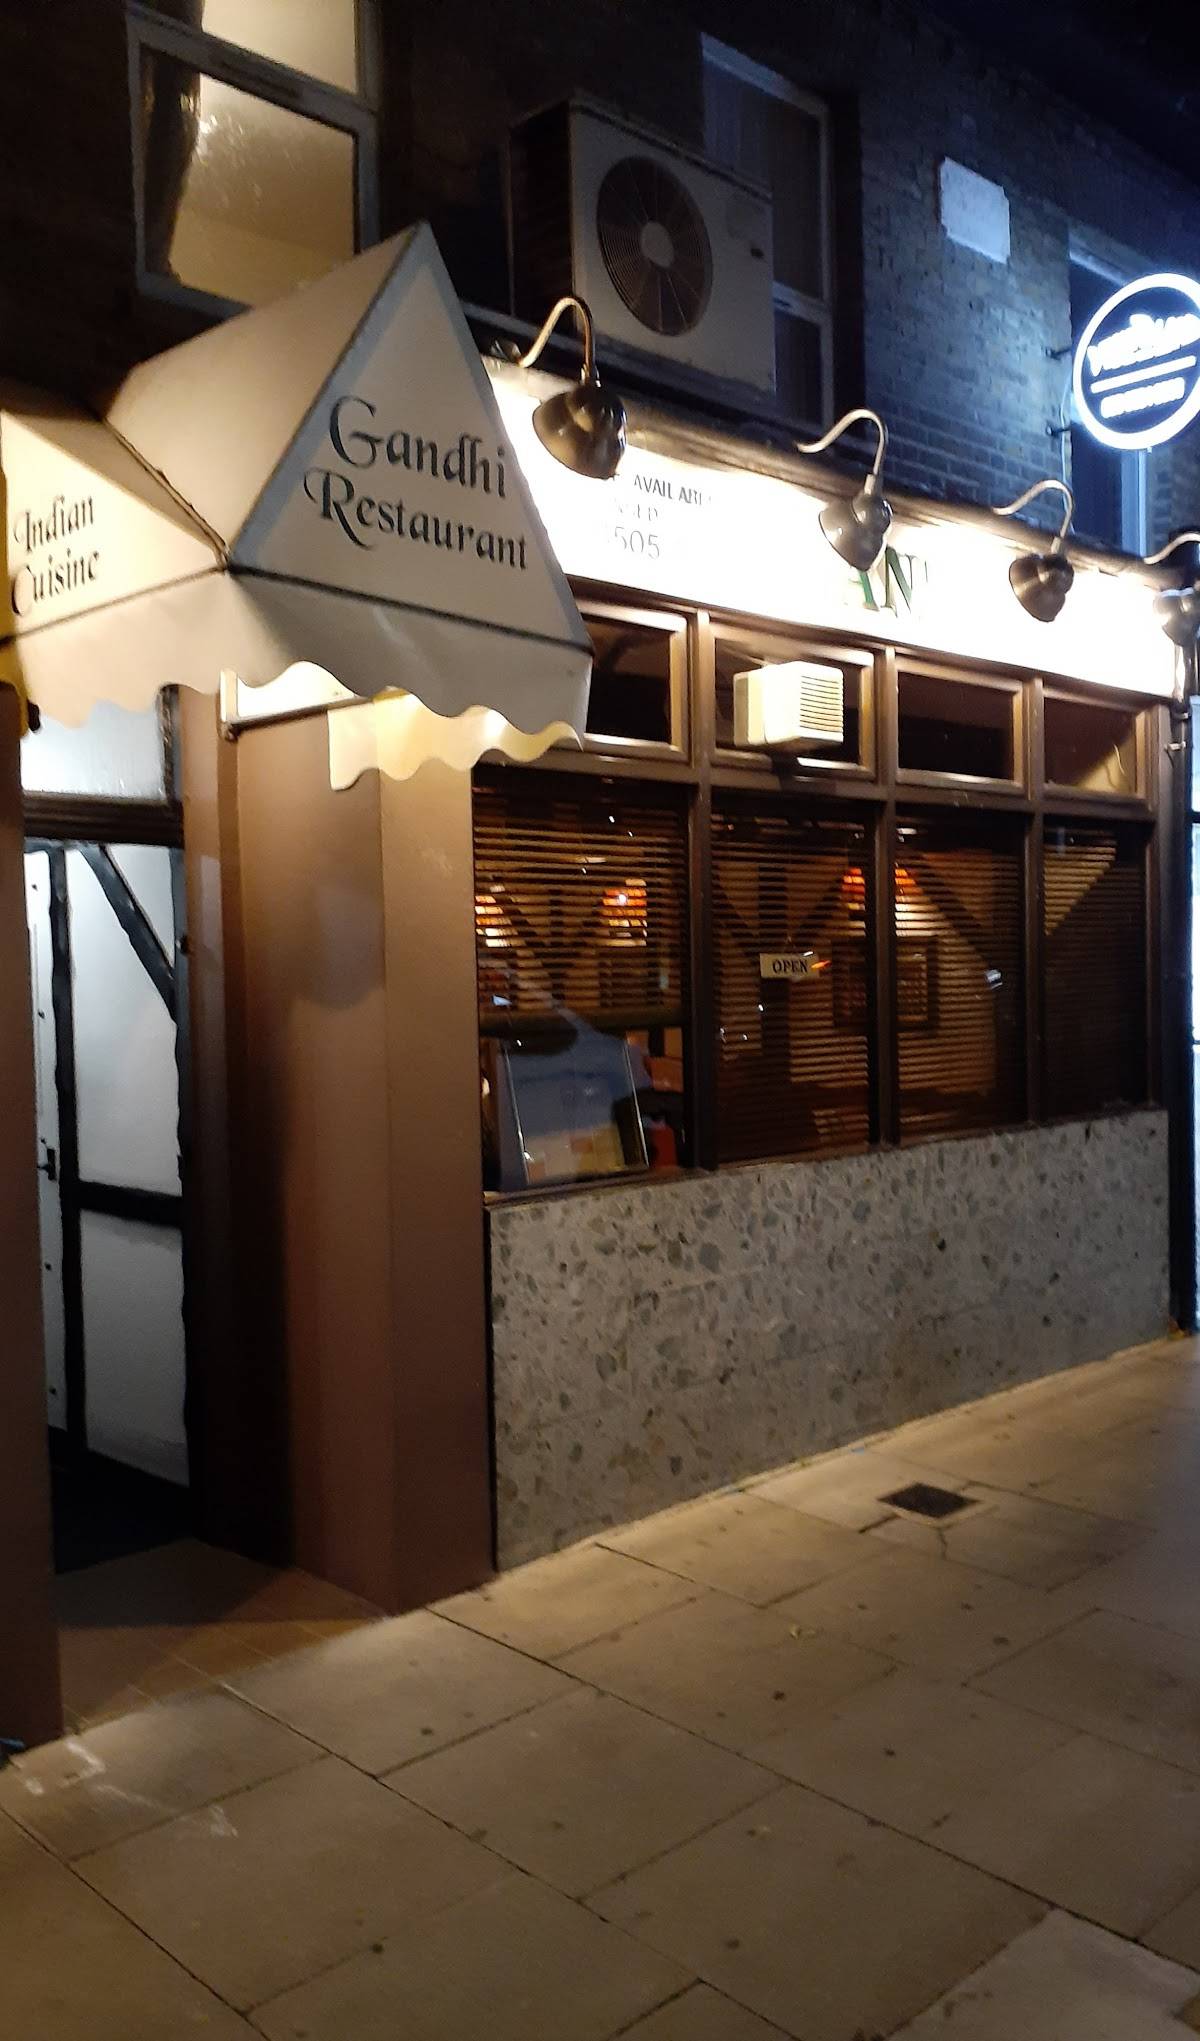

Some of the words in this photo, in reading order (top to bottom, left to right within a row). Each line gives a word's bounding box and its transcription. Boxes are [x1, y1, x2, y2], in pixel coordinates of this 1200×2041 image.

[329, 395, 506, 499] Gandhi
[13, 494, 95, 553] Indian
[303, 467, 527, 570] Restaurant
[11, 547, 100, 617] Cuisine
[772, 958, 809, 975] OPEN
